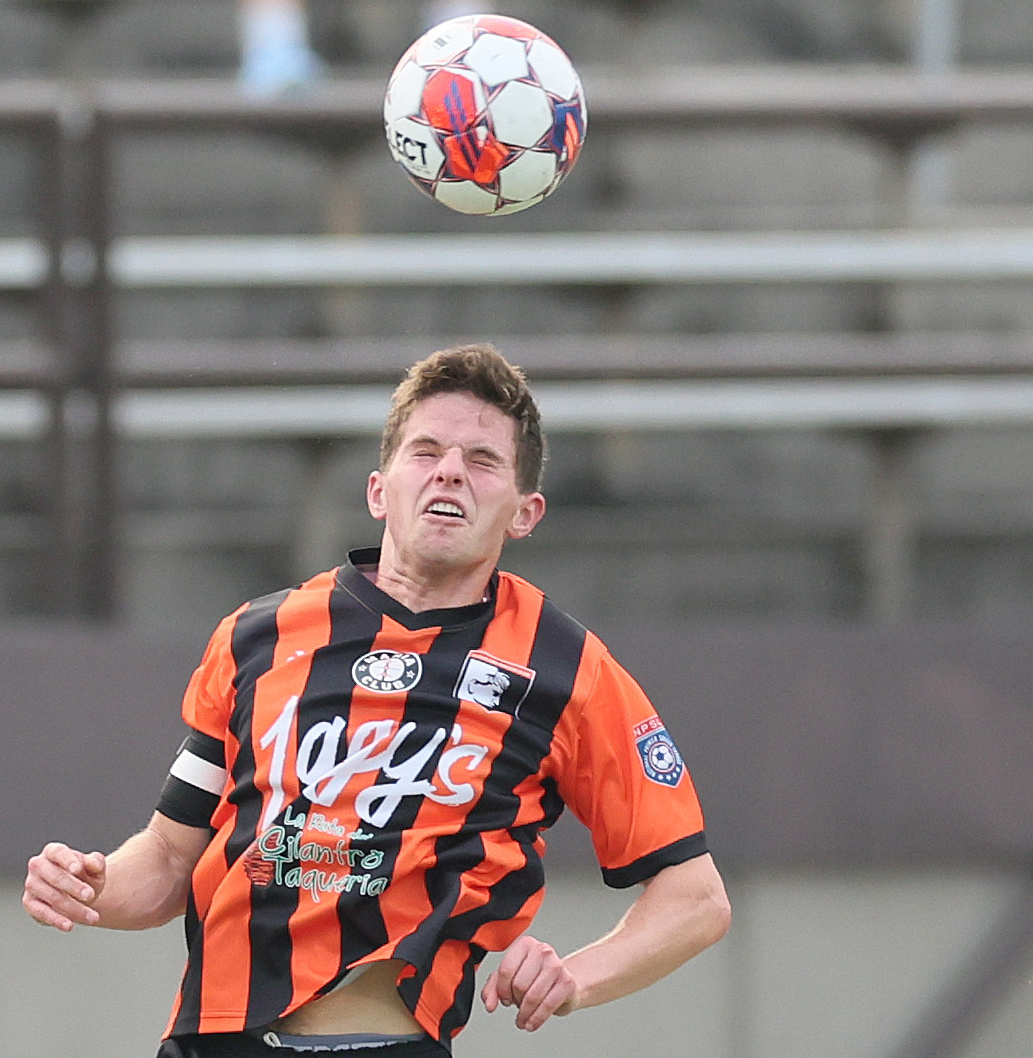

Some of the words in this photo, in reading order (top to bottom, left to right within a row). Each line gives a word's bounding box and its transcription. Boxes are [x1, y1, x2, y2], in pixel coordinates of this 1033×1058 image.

[390, 131, 427, 166] ECT
[360, 675, 406, 691] CLUB
[283, 805, 306, 829] La
[259, 825, 384, 870] Cilantro
[262, 854, 390, 903] Taqueria
